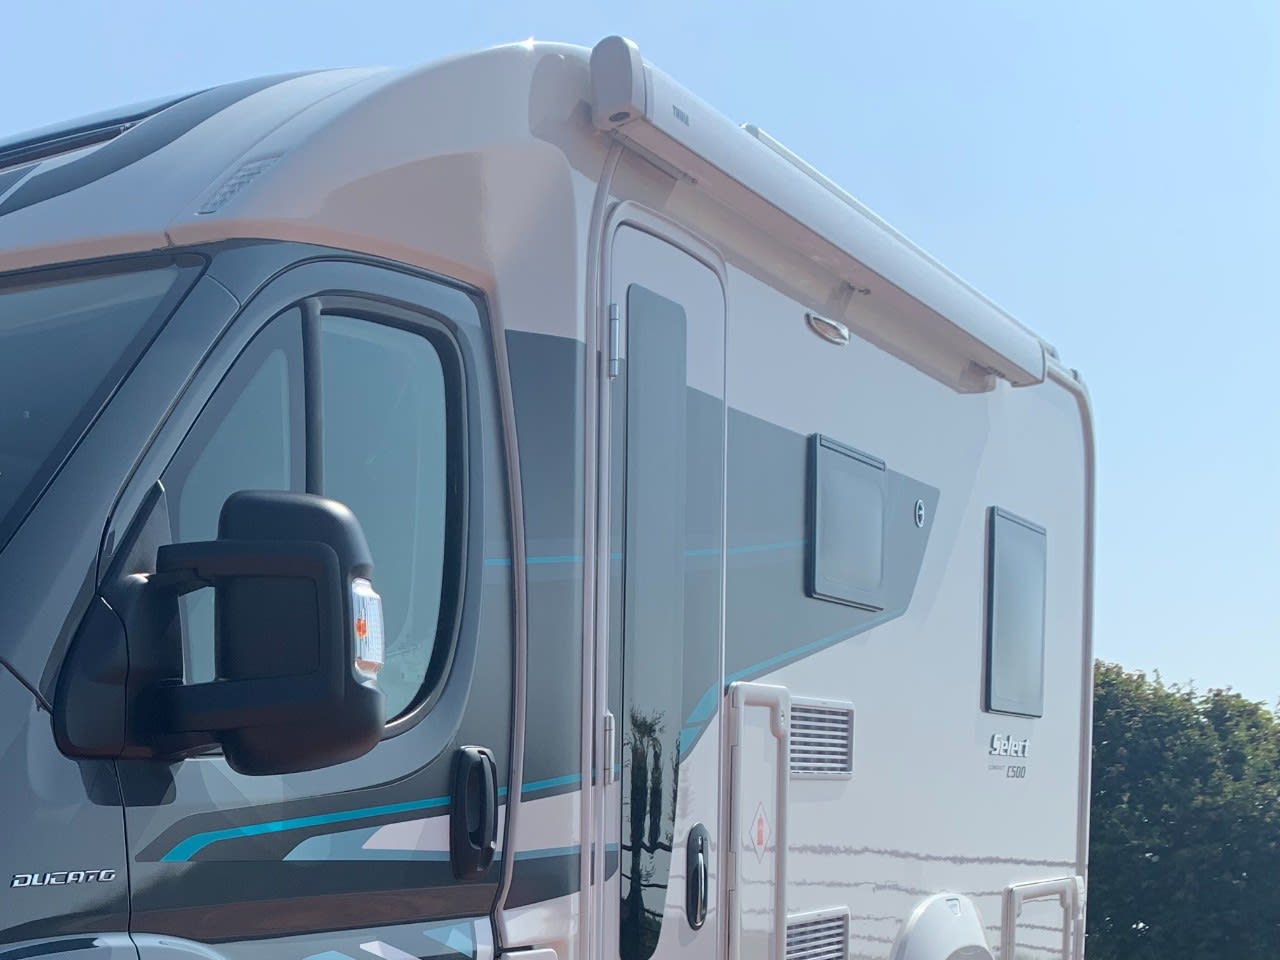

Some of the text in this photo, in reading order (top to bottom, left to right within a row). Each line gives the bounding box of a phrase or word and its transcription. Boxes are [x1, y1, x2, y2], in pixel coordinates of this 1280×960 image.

[989, 734, 1029, 758] Select
[1006, 766, 1026, 778] C500
[10, 869, 117, 888] DUCATO
